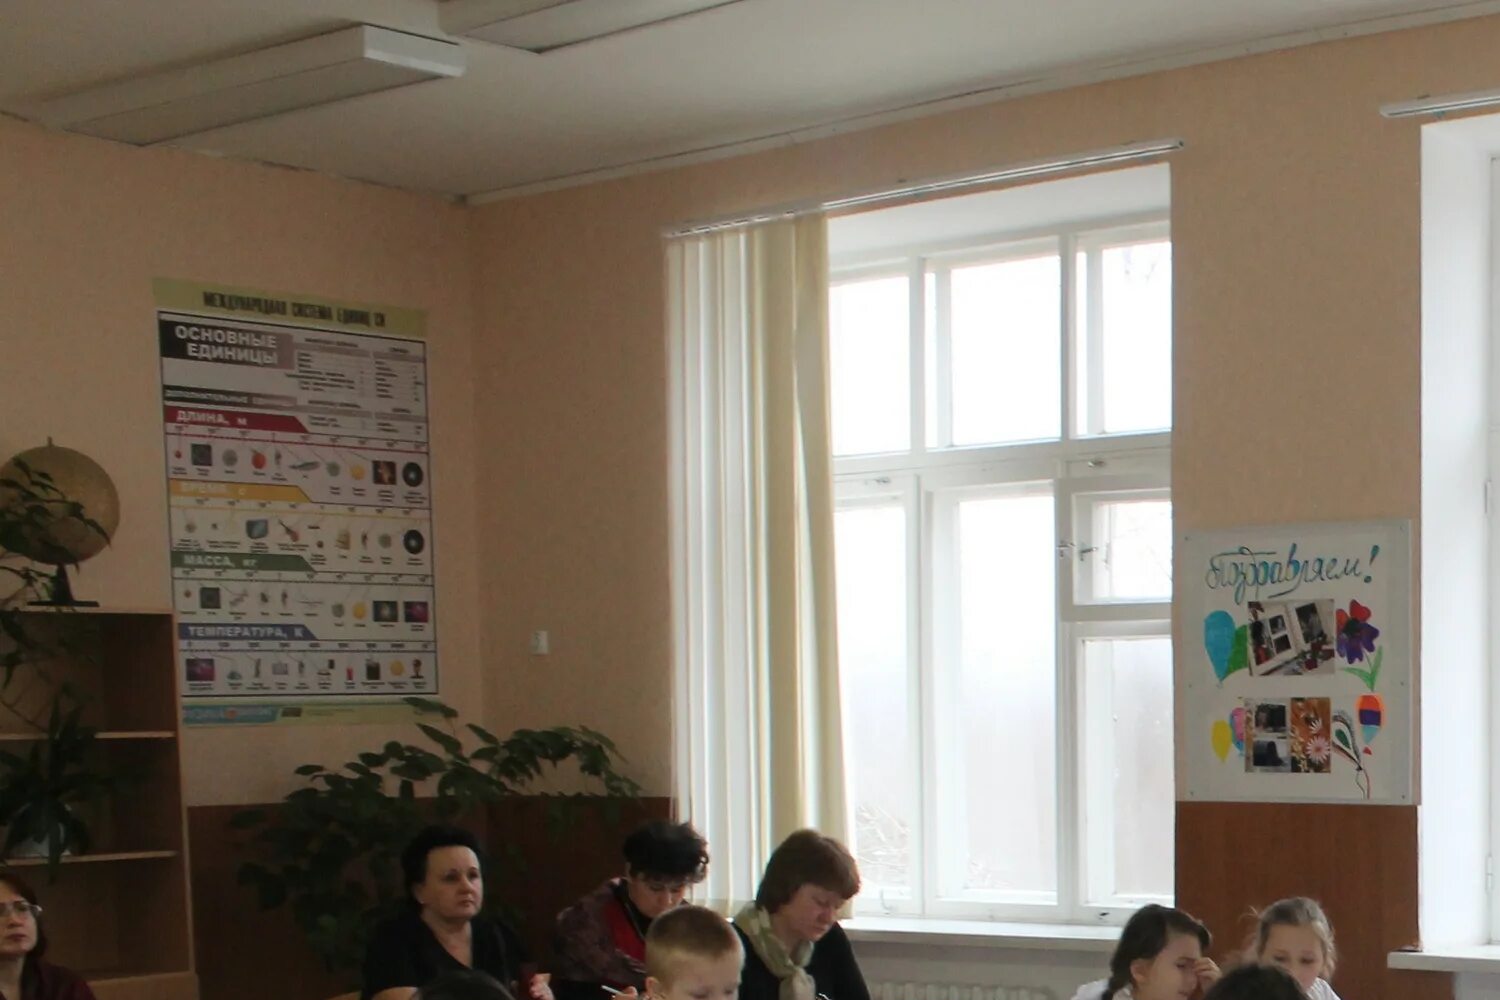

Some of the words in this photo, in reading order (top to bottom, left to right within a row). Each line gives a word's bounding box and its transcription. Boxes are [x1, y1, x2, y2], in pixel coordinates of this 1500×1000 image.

[175, 325, 278, 349] ОСНОВНЫЕ
[186, 342, 278, 365] ЕДИНИЦЫ
[176, 409, 229, 426] ДЛИНА,
[183, 554, 235, 568] МАССА,
[187, 626, 287, 639] ТЕМПЕРАТУРА,
